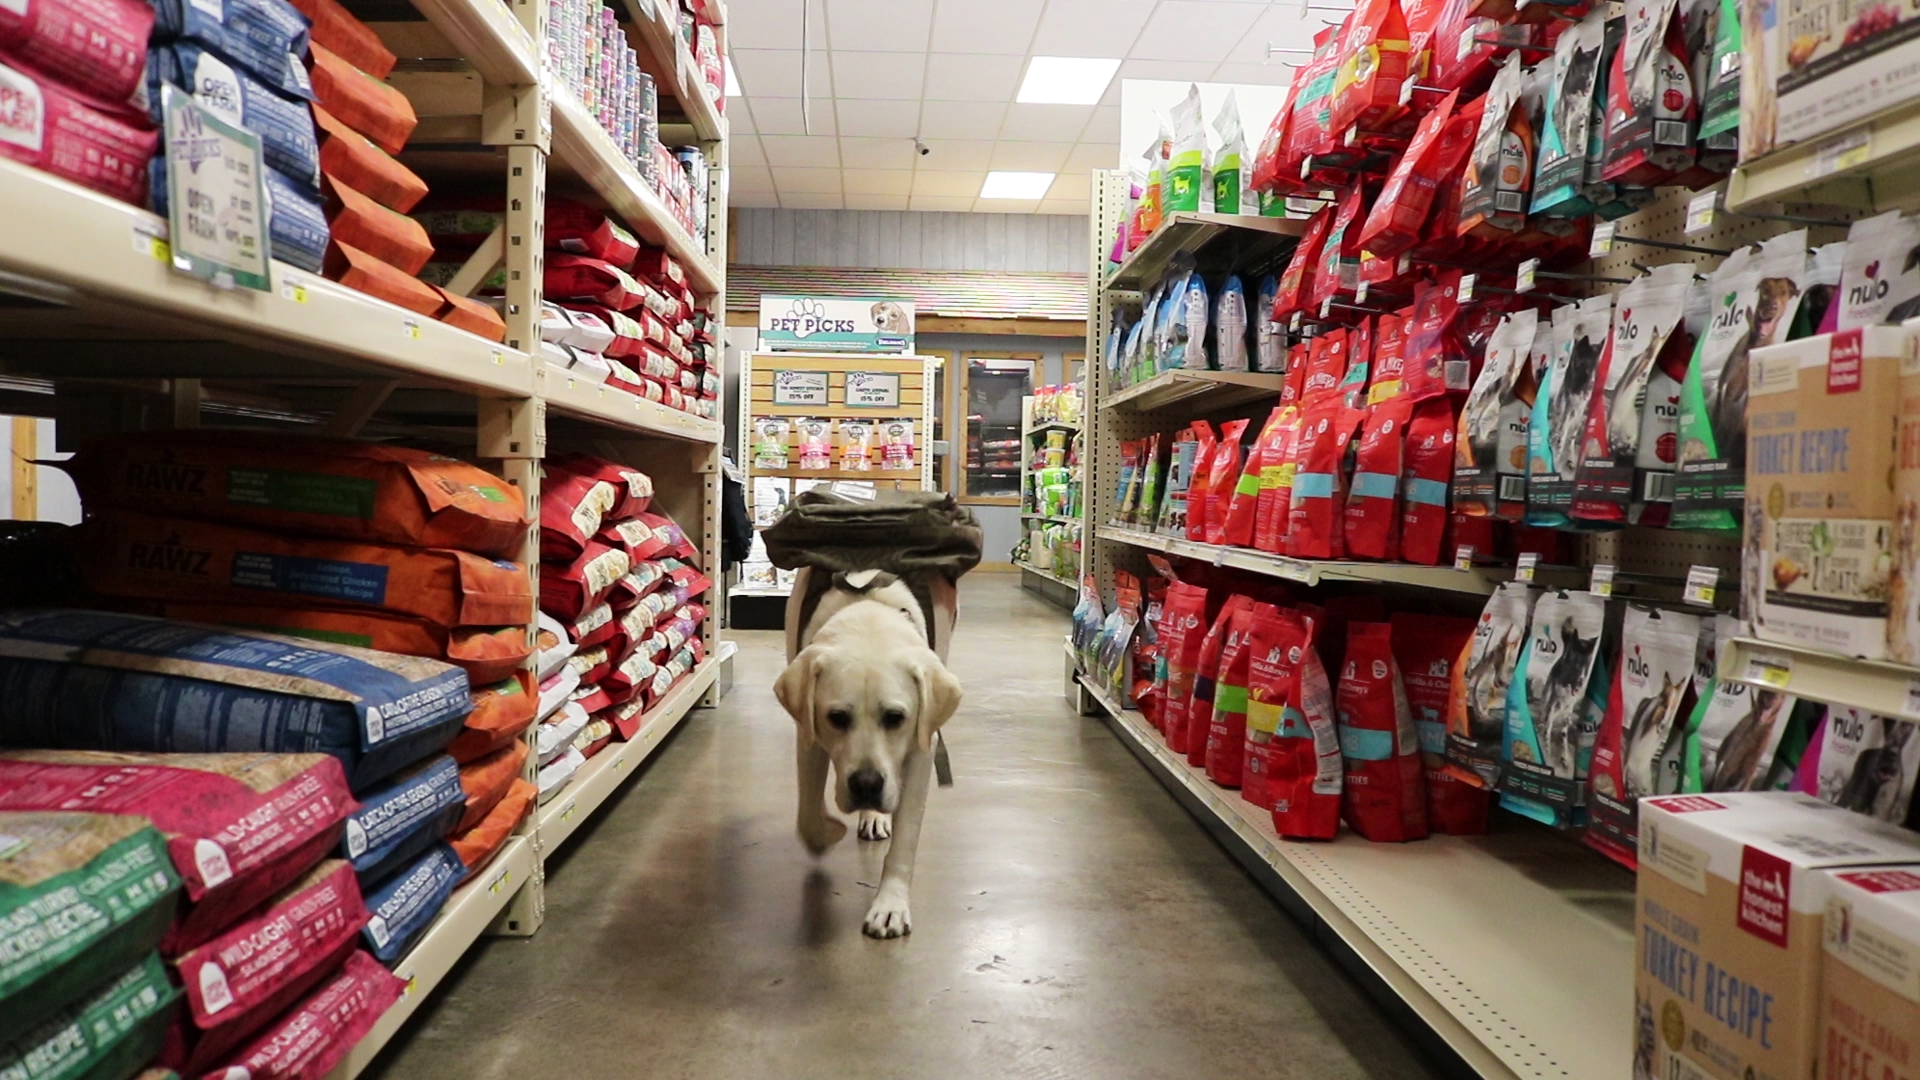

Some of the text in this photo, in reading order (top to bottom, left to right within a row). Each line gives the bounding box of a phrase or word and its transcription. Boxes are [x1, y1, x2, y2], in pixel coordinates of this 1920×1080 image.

[1661, 69, 1685, 81] nulo
[1502, 148, 1523, 158] nulo
[1849, 272, 1889, 305] nulo
[770, 318, 855, 333] PET PICKS
[1712, 302, 1744, 329] nulo
[128, 543, 213, 576] RAWZ
[1628, 655, 1649, 678] nulo
[1833, 713, 1864, 742] nulo
[1643, 924, 1774, 1050] TURKEY RECIPE
